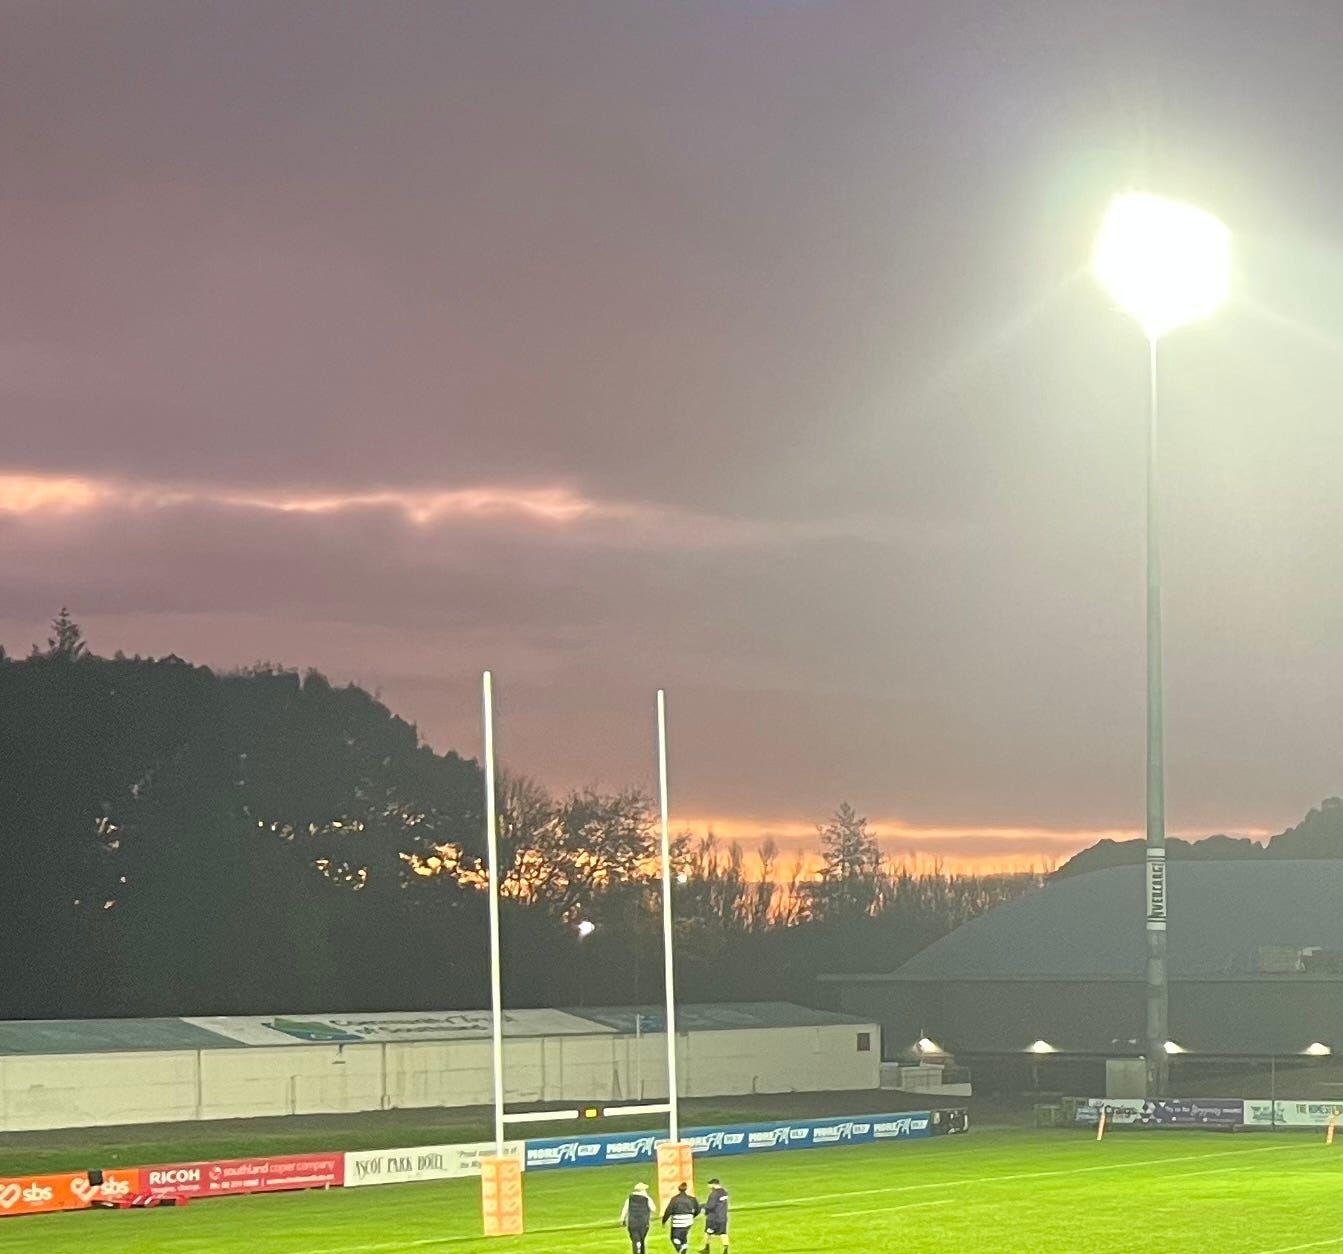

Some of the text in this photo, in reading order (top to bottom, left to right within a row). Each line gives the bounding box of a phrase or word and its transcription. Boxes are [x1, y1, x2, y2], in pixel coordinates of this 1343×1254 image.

[387, 1156, 413, 1174] PARK
[101, 1175, 130, 1196] sbs
[149, 1168, 201, 1185] RICOH
[22, 1182, 53, 1202] sbs
